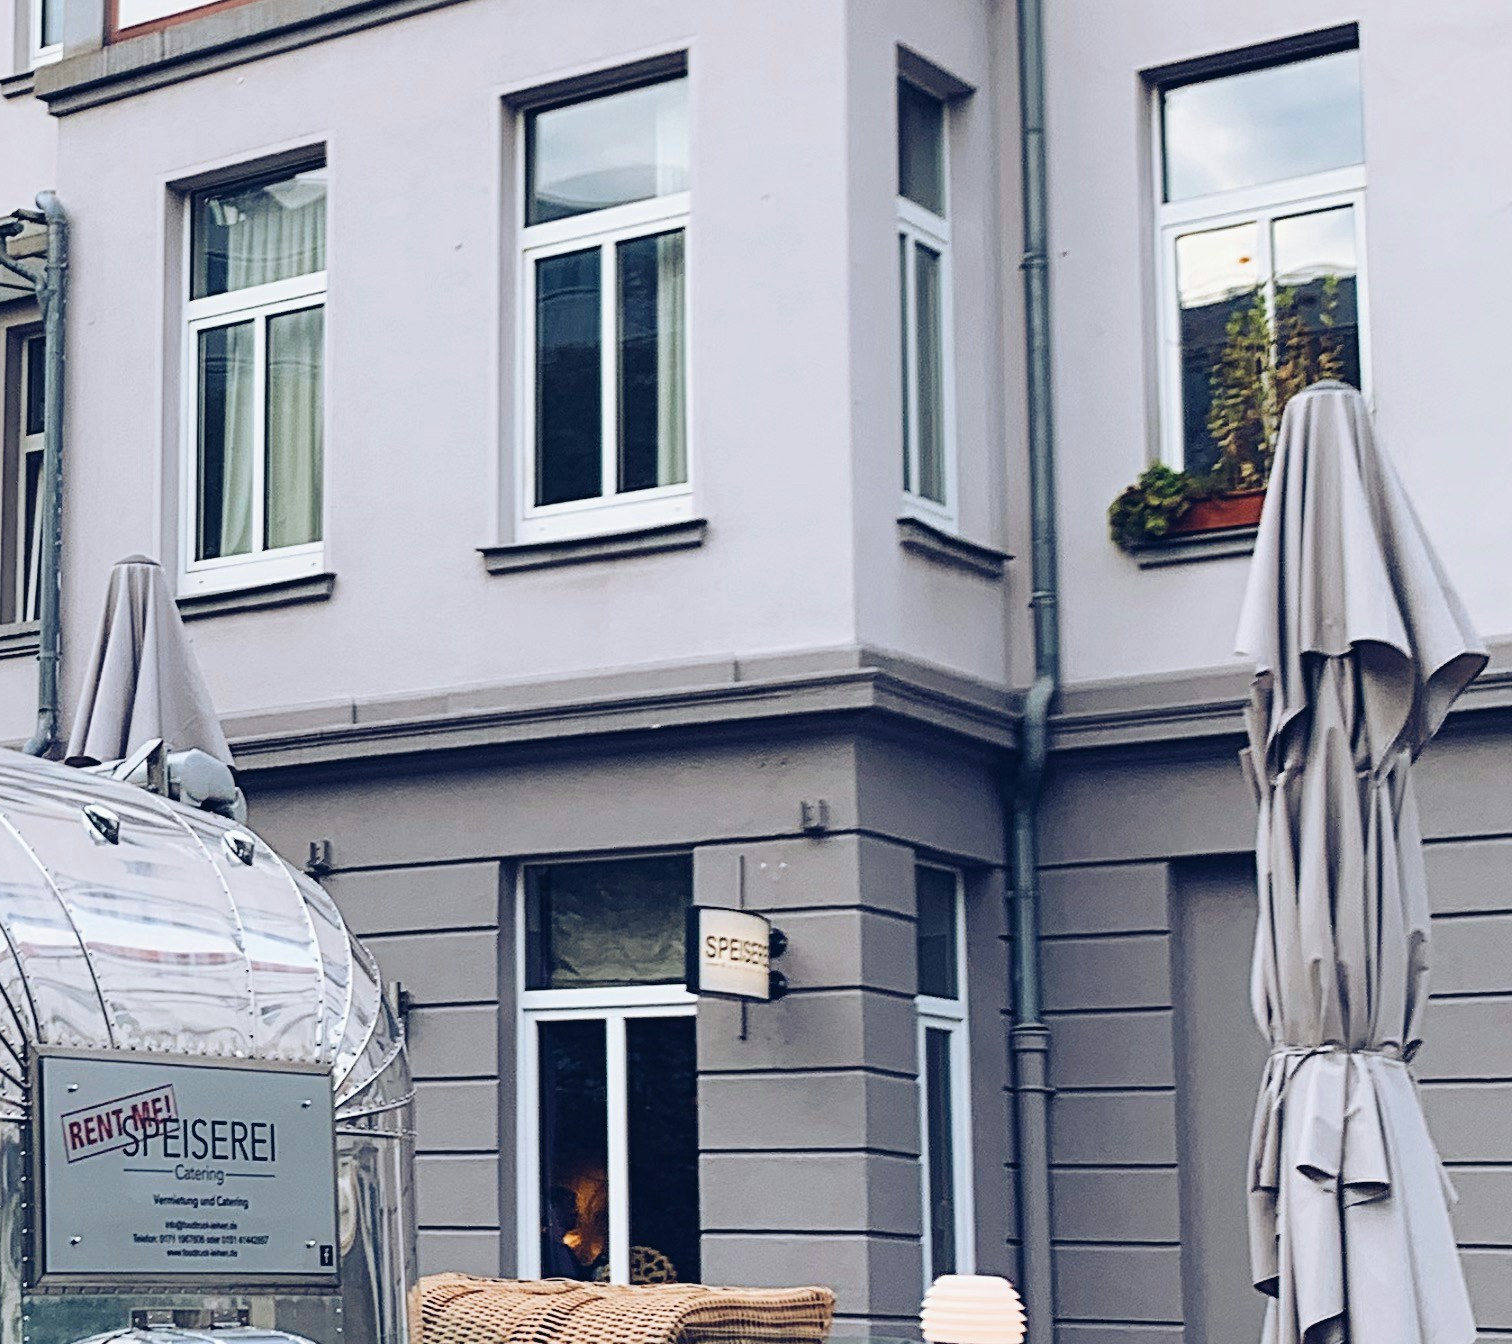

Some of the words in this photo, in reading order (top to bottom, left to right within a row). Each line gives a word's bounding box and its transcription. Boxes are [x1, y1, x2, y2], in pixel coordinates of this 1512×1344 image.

[68, 1108, 124, 1151] RENT
[129, 1095, 172, 1133] ME!
[122, 1115, 276, 1162] SPEISEREI
[174, 1163, 225, 1186] Catering
[153, 1194, 199, 1208] Vermietung
[200, 1196, 215, 1206] und
[217, 1196, 249, 1210] Catering
